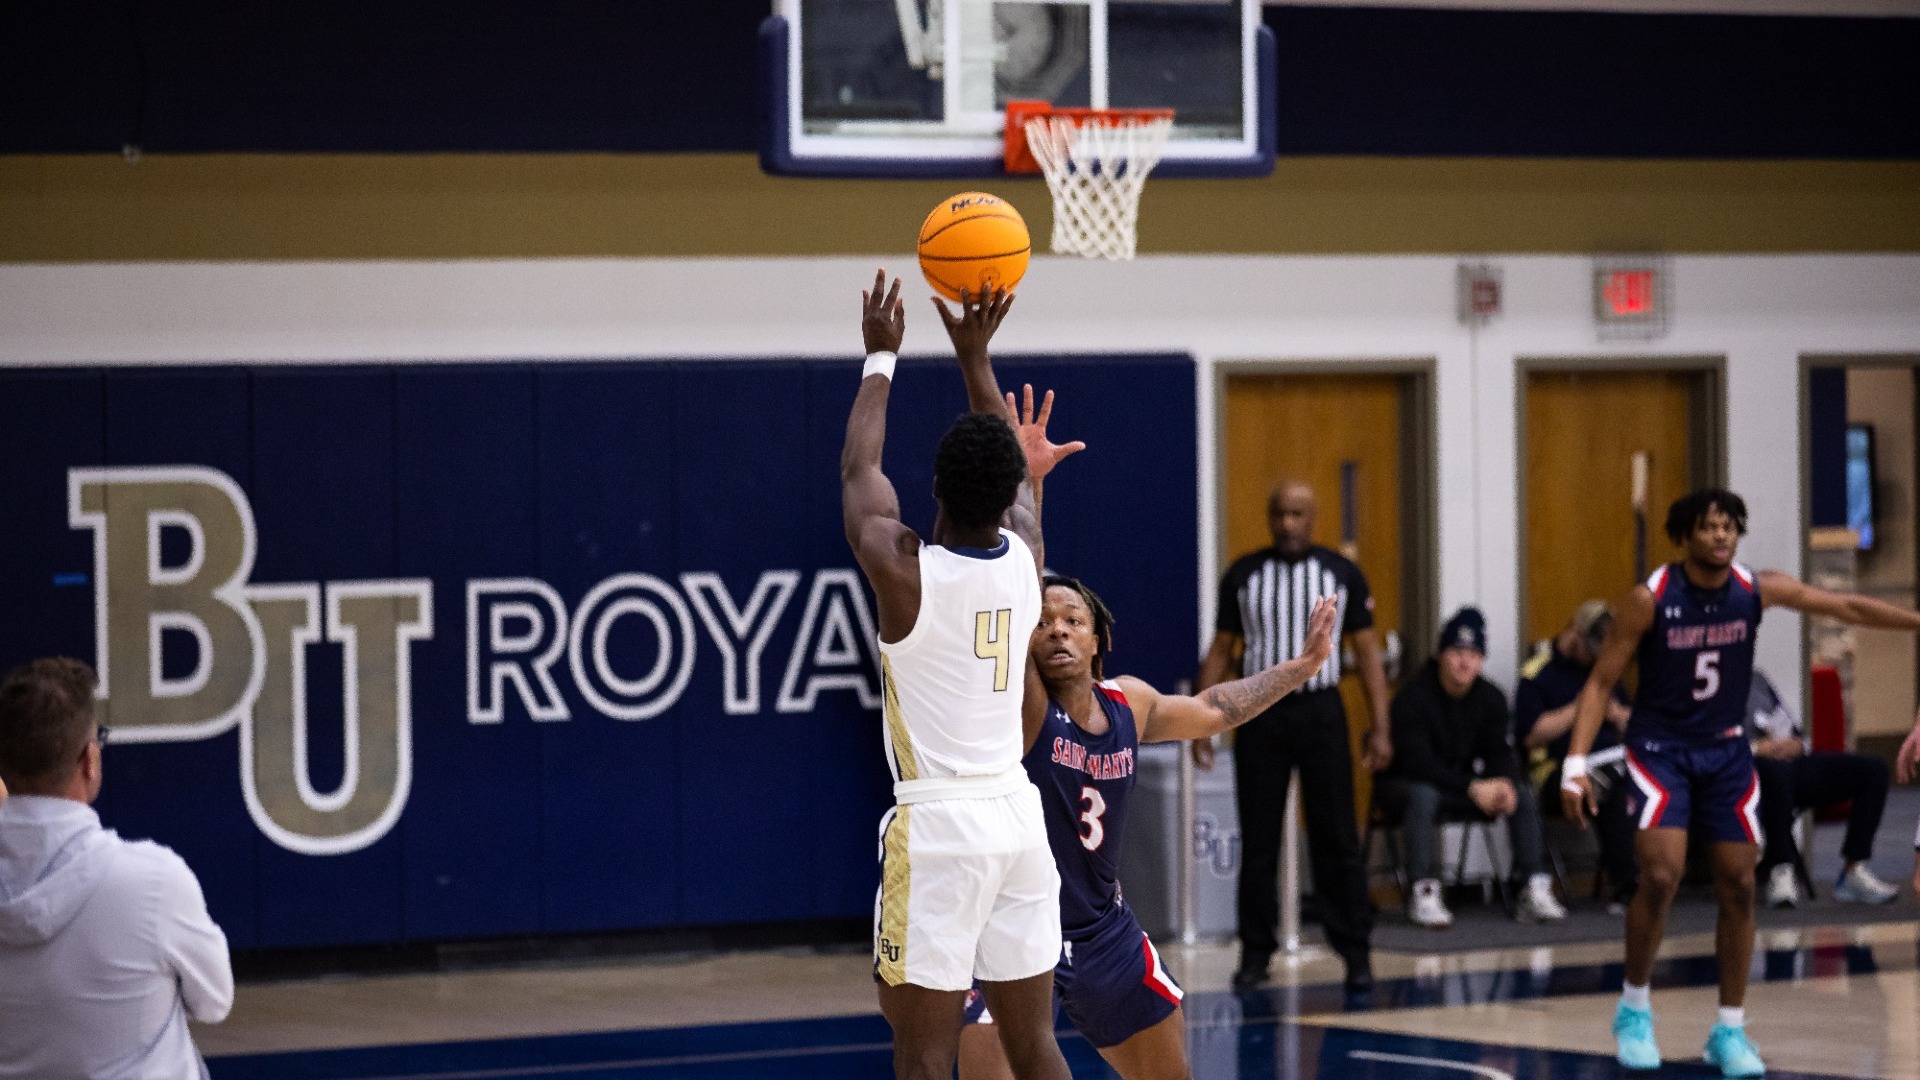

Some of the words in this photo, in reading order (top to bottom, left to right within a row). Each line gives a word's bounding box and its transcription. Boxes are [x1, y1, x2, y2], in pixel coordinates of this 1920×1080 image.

[67, 465, 434, 857] BU
[974, 608, 1011, 692] 4
[1691, 651, 1721, 701] 5
[1051, 736, 1087, 772] SAIN
[1079, 785, 1106, 851] 3
[881, 938, 900, 962] BU
